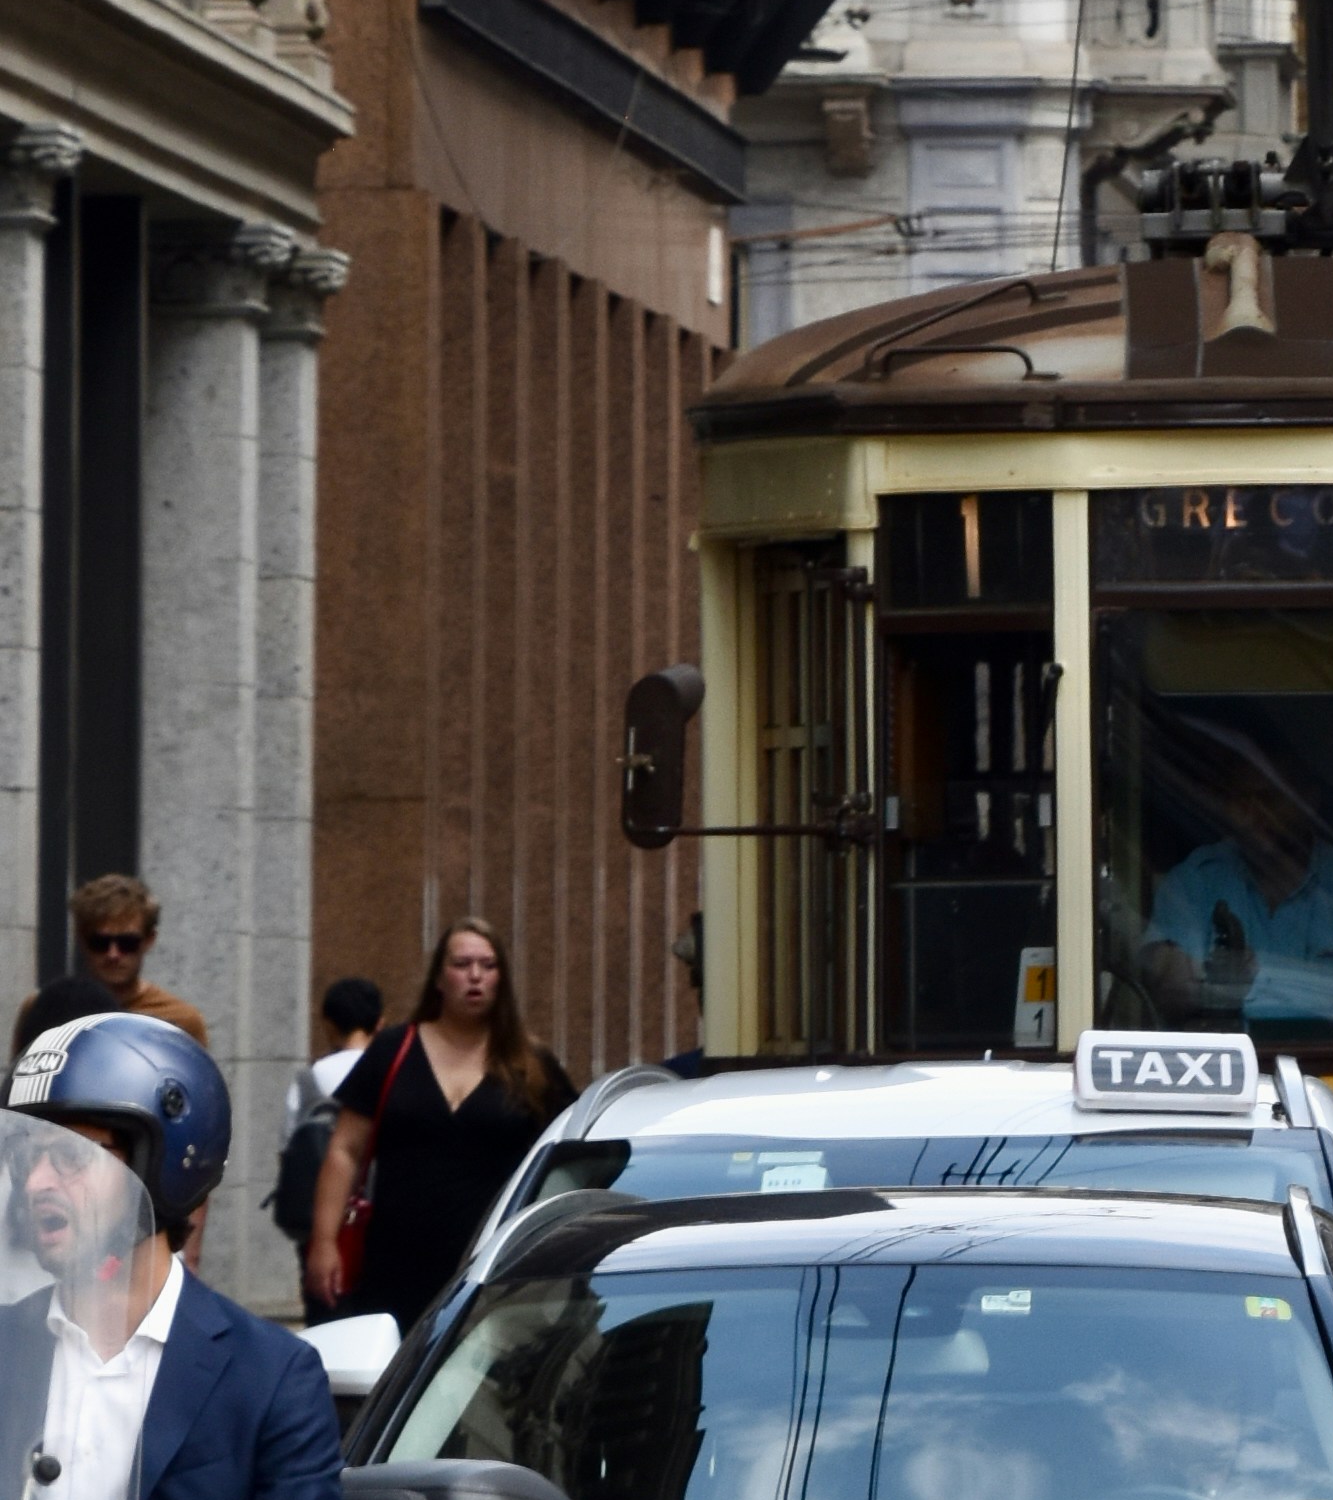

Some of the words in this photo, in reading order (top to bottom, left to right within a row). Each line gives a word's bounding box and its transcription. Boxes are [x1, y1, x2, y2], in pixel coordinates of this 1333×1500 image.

[1036, 968, 1048, 994] 1
[1033, 1007, 1044, 1039] 1
[1098, 1049, 1233, 1087] TAXI
